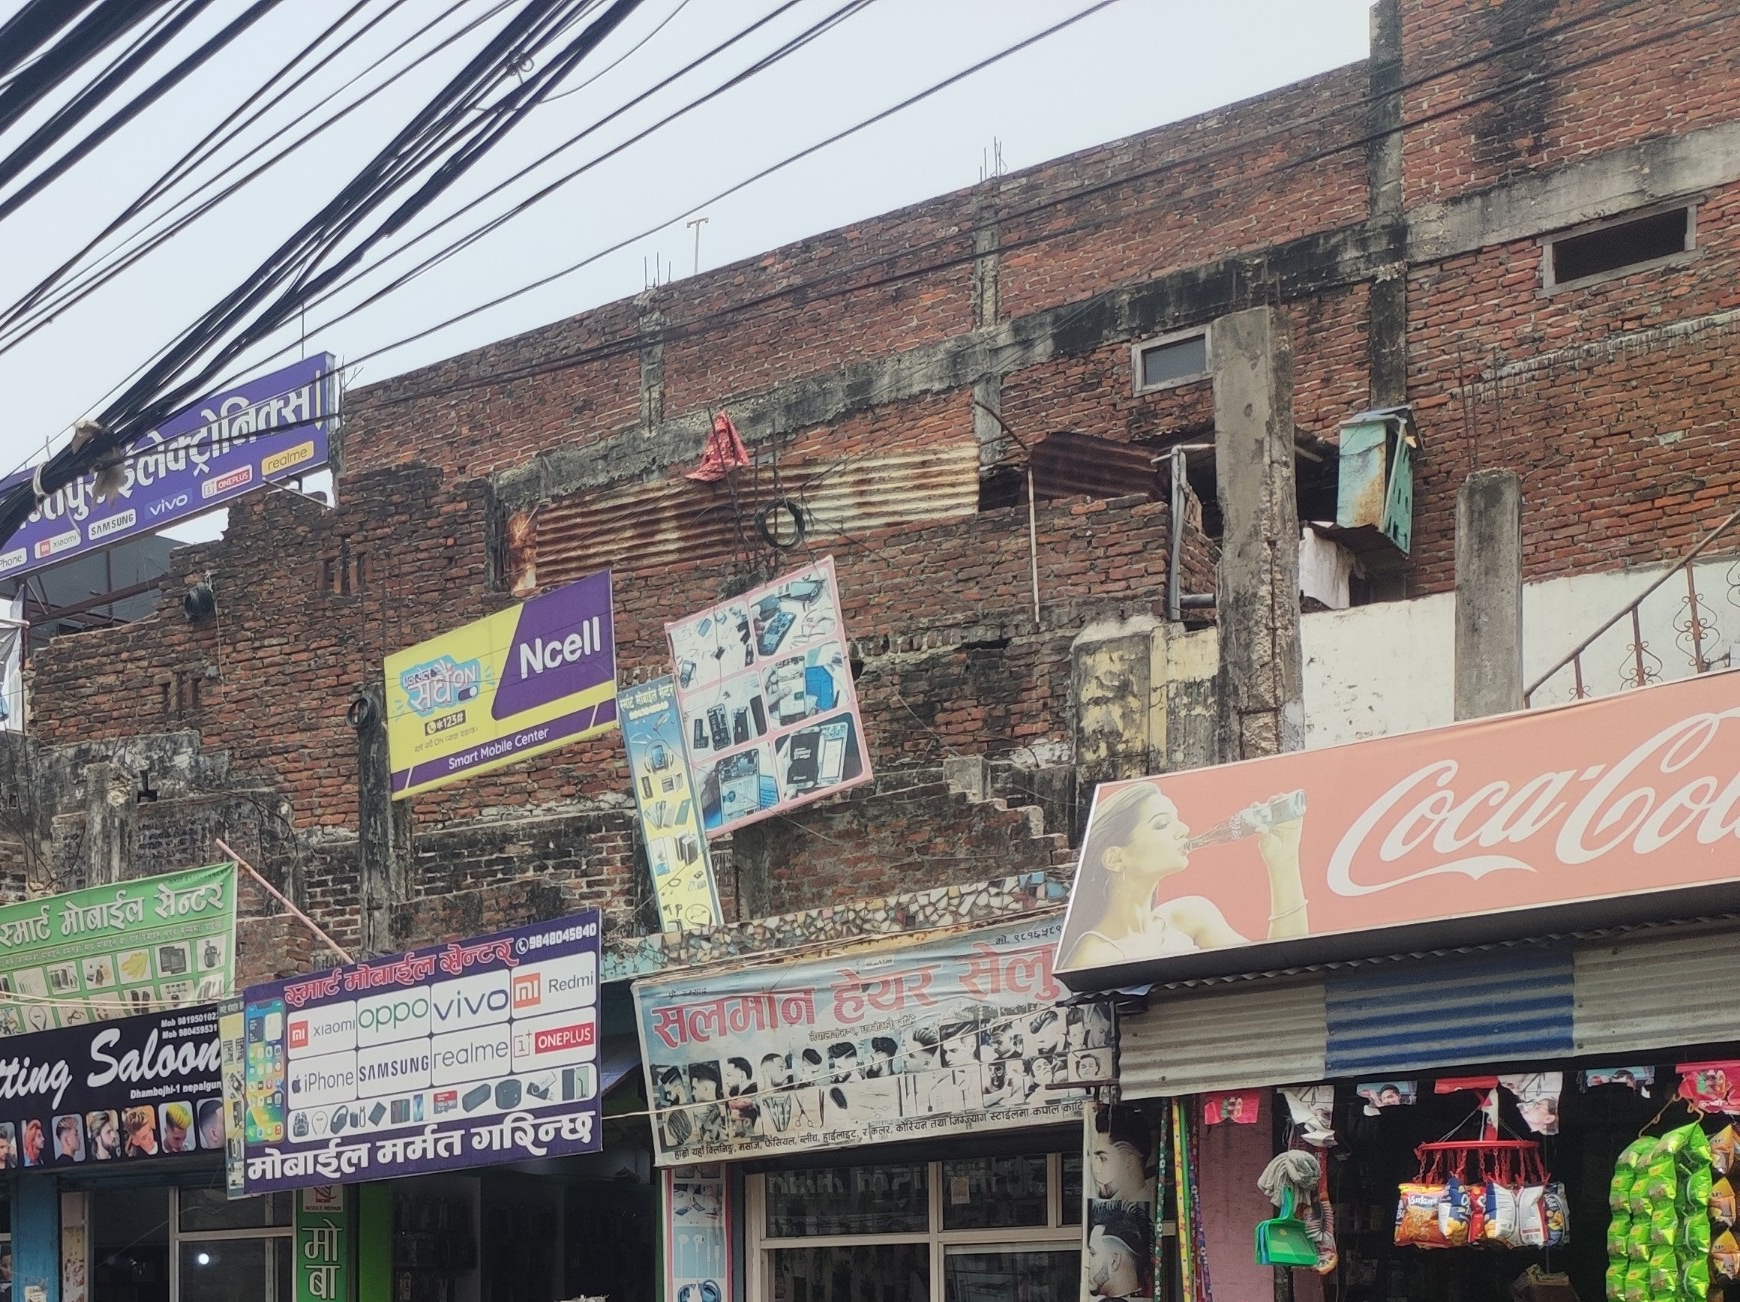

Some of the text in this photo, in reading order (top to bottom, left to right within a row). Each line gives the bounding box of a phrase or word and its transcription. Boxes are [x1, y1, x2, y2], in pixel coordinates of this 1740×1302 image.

[268, 447, 308, 471] realme
[218, 471, 250, 489] ONEPLUS
[149, 494, 189, 516] vivo
[91, 515, 134, 536] SAMSUNG
[52, 535, 77, 549] xiaomi
[519, 616, 602, 680] Ncell
[448, 727, 550, 770] Smart Mobile Center
[58, 889, 144, 937] मोबाईल
[153, 881, 224, 919] सेन्टर
[284, 922, 597, 1008] स्मार्ट मोबाईल सेन्टर 9848045840
[547, 971, 594, 994] Redmi
[651, 940, 1061, 1048] सलमान हेयर सेलु
[358, 997, 429, 1032] oppo
[432, 989, 510, 1021] vivo
[161, 1018, 176, 1028] Mob
[162, 1023, 218, 1039] Mob 980459531
[313, 1017, 356, 1038] xiaomi
[537, 1027, 592, 1049] ONEPLUS
[87, 1028, 222, 1090] Saloon
[433, 1039, 509, 1069] realme
[358, 1054, 430, 1082] SAMSUNG
[182, 1080, 222, 1094] nepalgun
[303, 1068, 355, 1093] iPhone
[930, 1116, 948, 1128] तथा
[246, 1109, 596, 1182] मोबाईल मर्मत गरिन्छ
